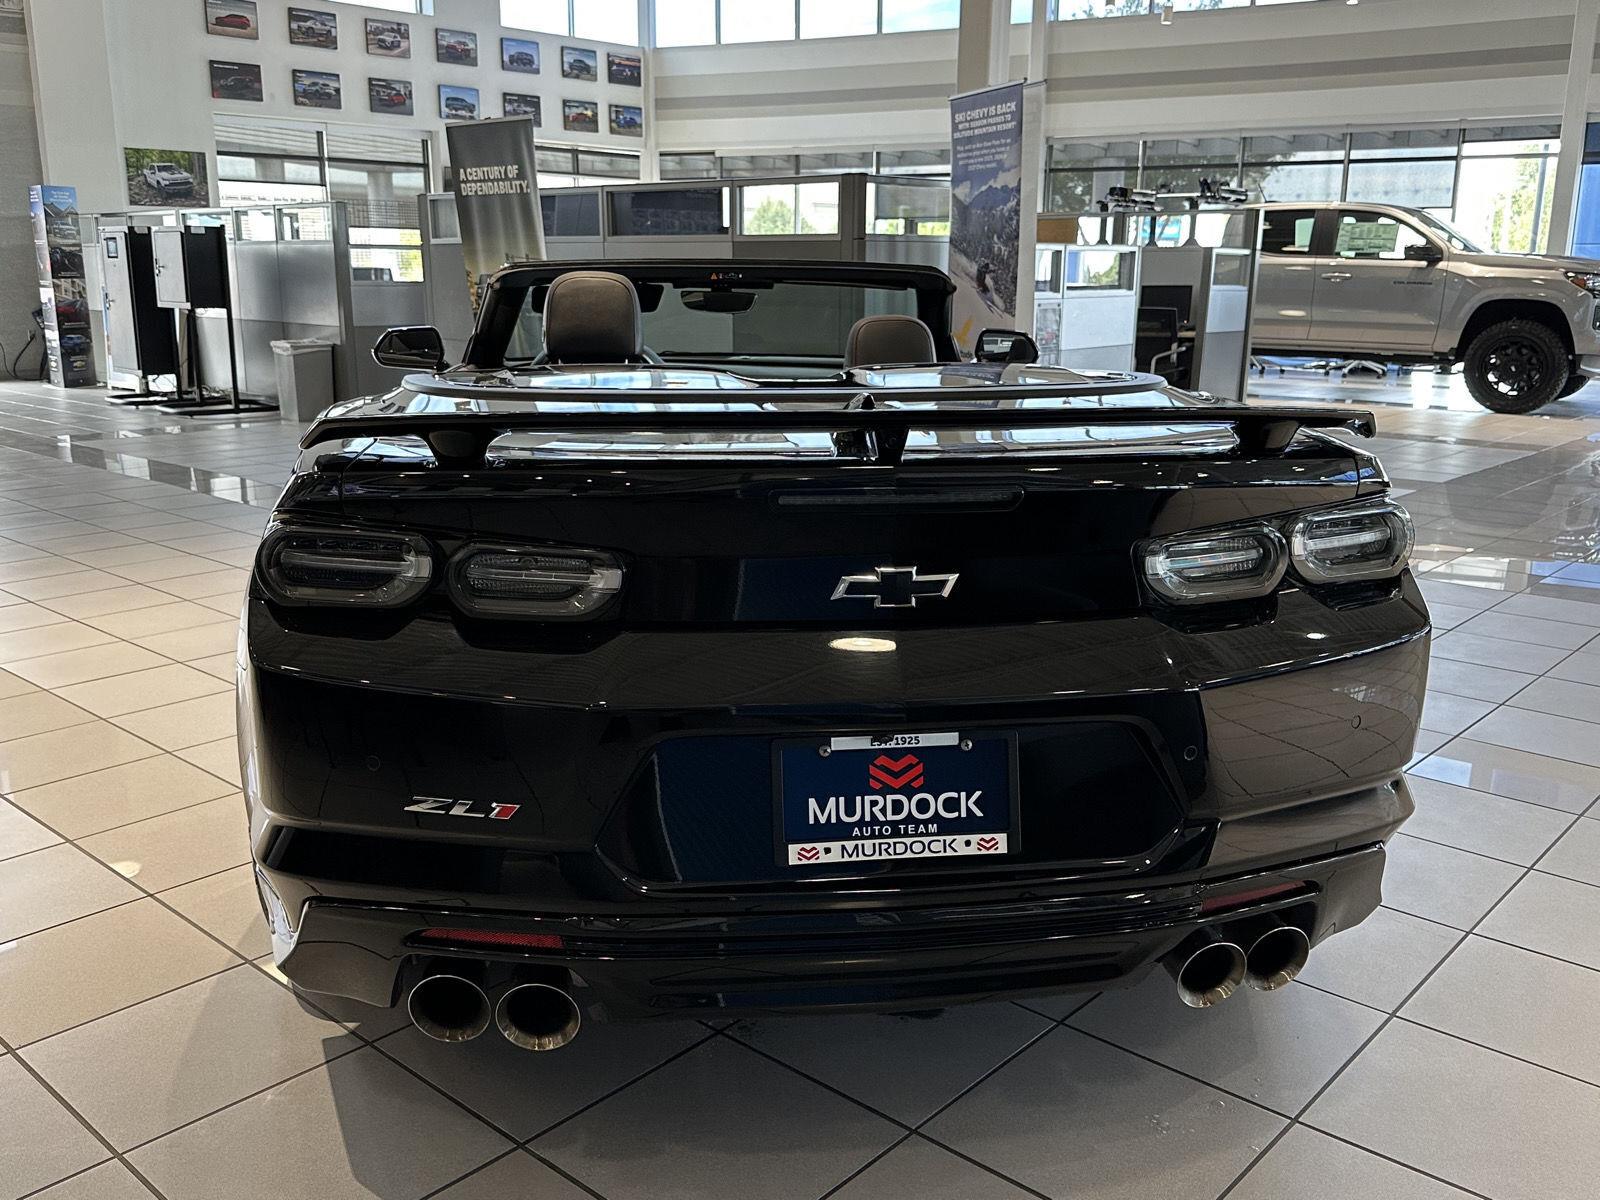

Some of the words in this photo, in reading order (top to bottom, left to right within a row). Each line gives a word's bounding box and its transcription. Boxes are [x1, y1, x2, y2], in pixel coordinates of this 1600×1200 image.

[954, 113, 966, 123] SKI
[966, 107, 988, 120] CHEVY
[988, 105, 996, 116] IS
[996, 102, 1016, 114] BACK
[459, 168, 467, 182] A
[466, 166, 506, 180] CENTURY
[507, 164, 519, 179] OF
[460, 180, 531, 196] DEPENDABILITY.
[894, 735, 920, 745] 1925
[403, 795, 521, 820] ZL1
[808, 790, 984, 825] MURDOCK
[852, 825, 891, 837] AUTO
[898, 823, 938, 835] TEAM
[840, 838, 959, 859] MURDOCK
